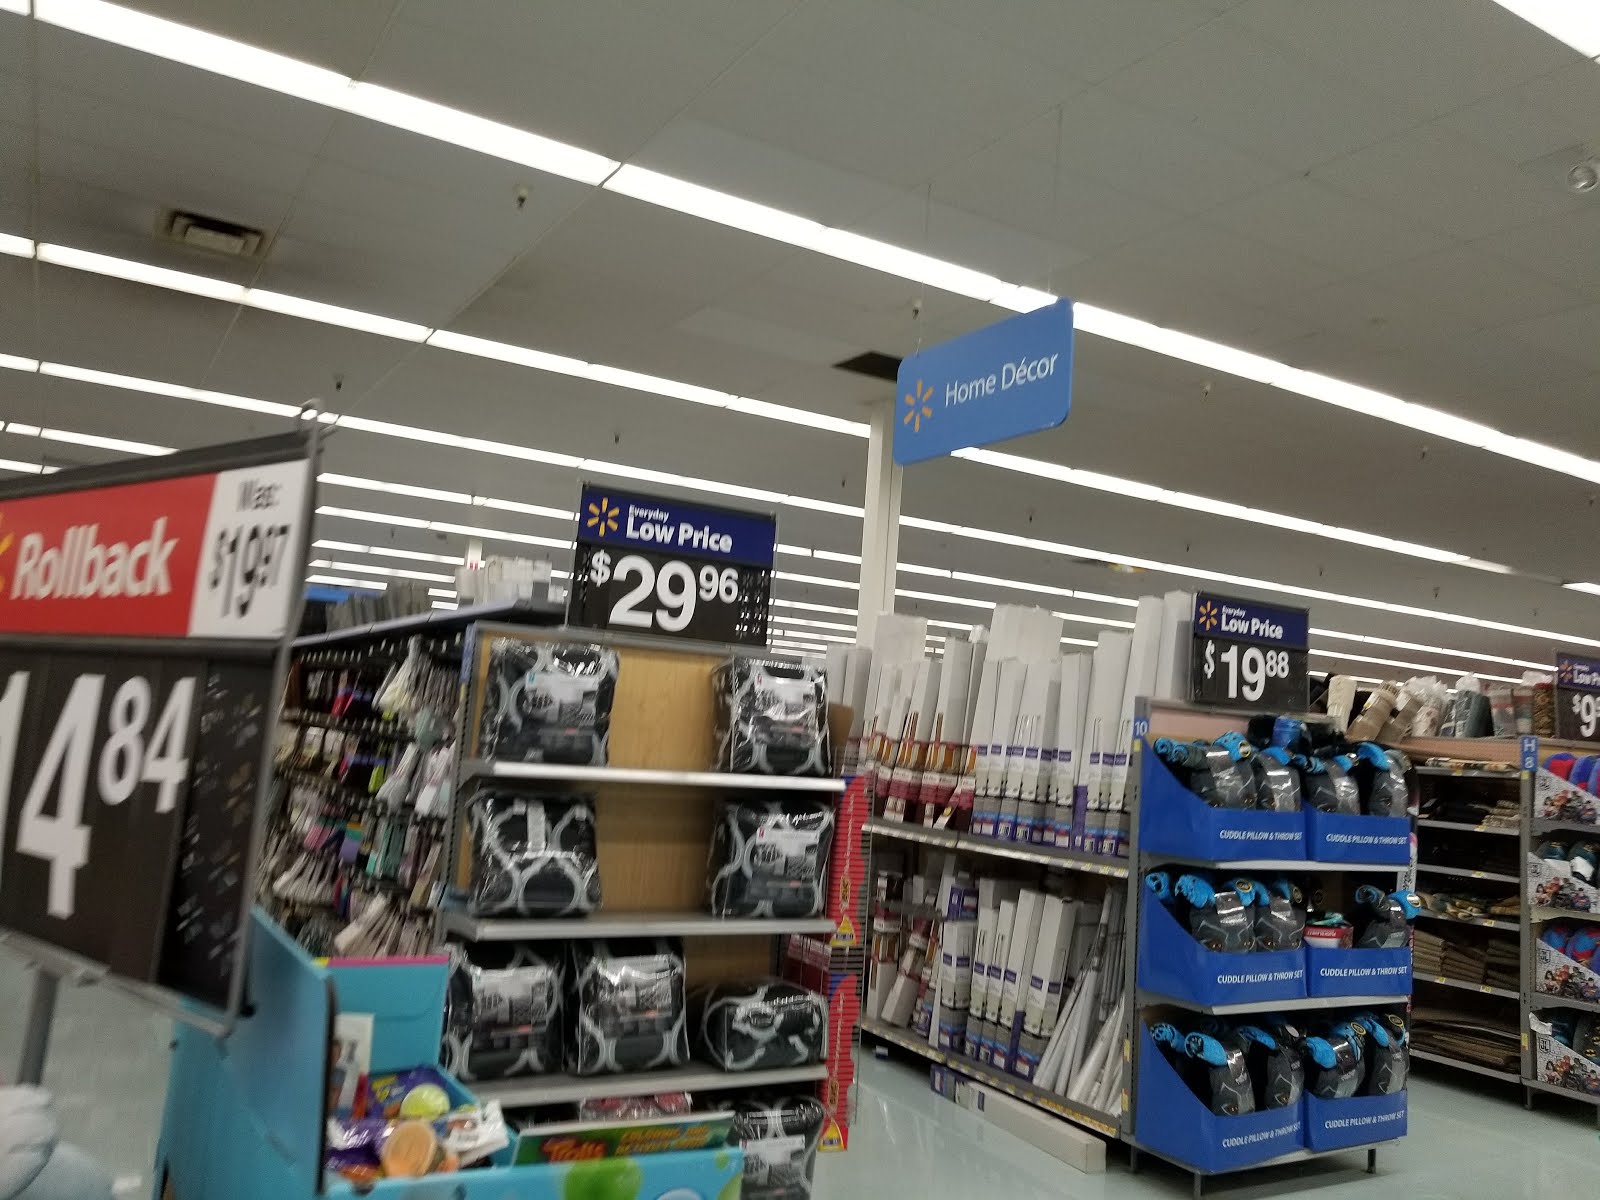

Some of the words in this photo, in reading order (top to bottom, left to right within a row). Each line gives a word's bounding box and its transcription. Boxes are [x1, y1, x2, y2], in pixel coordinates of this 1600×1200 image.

[945, 373, 996, 408] Home
[1001, 353, 1058, 390] Décor
[628, 504, 669, 522] Everyday
[626, 517, 675, 544] Low
[677, 522, 733, 553] Price
[10, 516, 179, 600] Rollback
[1222, 605, 1246, 618] Everyday
[1221, 613, 1249, 634] Low
[1251, 617, 1284, 639] Price
[1135, 721, 1148, 736] 10
[1523, 738, 1535, 752] H
[1219, 830, 1246, 839] CUDDLE
[1246, 831, 1269, 840] PILLOW
[1274, 831, 1294, 840] THROW
[1294, 831, 1303, 840] SET
[1326, 833, 1352, 843] CUDDLE
[1352, 836, 1373, 844] PILLOW
[1379, 836, 1398, 845] THROW
[1398, 836, 1407, 845] SET
[1217, 975, 1245, 984] CUDDLE
[1245, 973, 1267, 983] PILLOW
[1273, 971, 1294, 981] THROW
[1294, 970, 1303, 978] SET
[1320, 968, 1347, 977] CUDDLE
[1348, 968, 1371, 977] PILLOW
[1377, 967, 1398, 975] THROW
[1398, 966, 1407, 974] SET
[1324, 1119, 1349, 1129] CUDDLE
[1350, 1117, 1371, 1127] PILLOW
[1377, 1113, 1397, 1123] THROW
[1397, 1110, 1405, 1119] SET
[1222, 1135, 1248, 1148] CUDDLE
[1248, 1131, 1270, 1143] PILLOW
[1274, 1125, 1293, 1136] THROW
